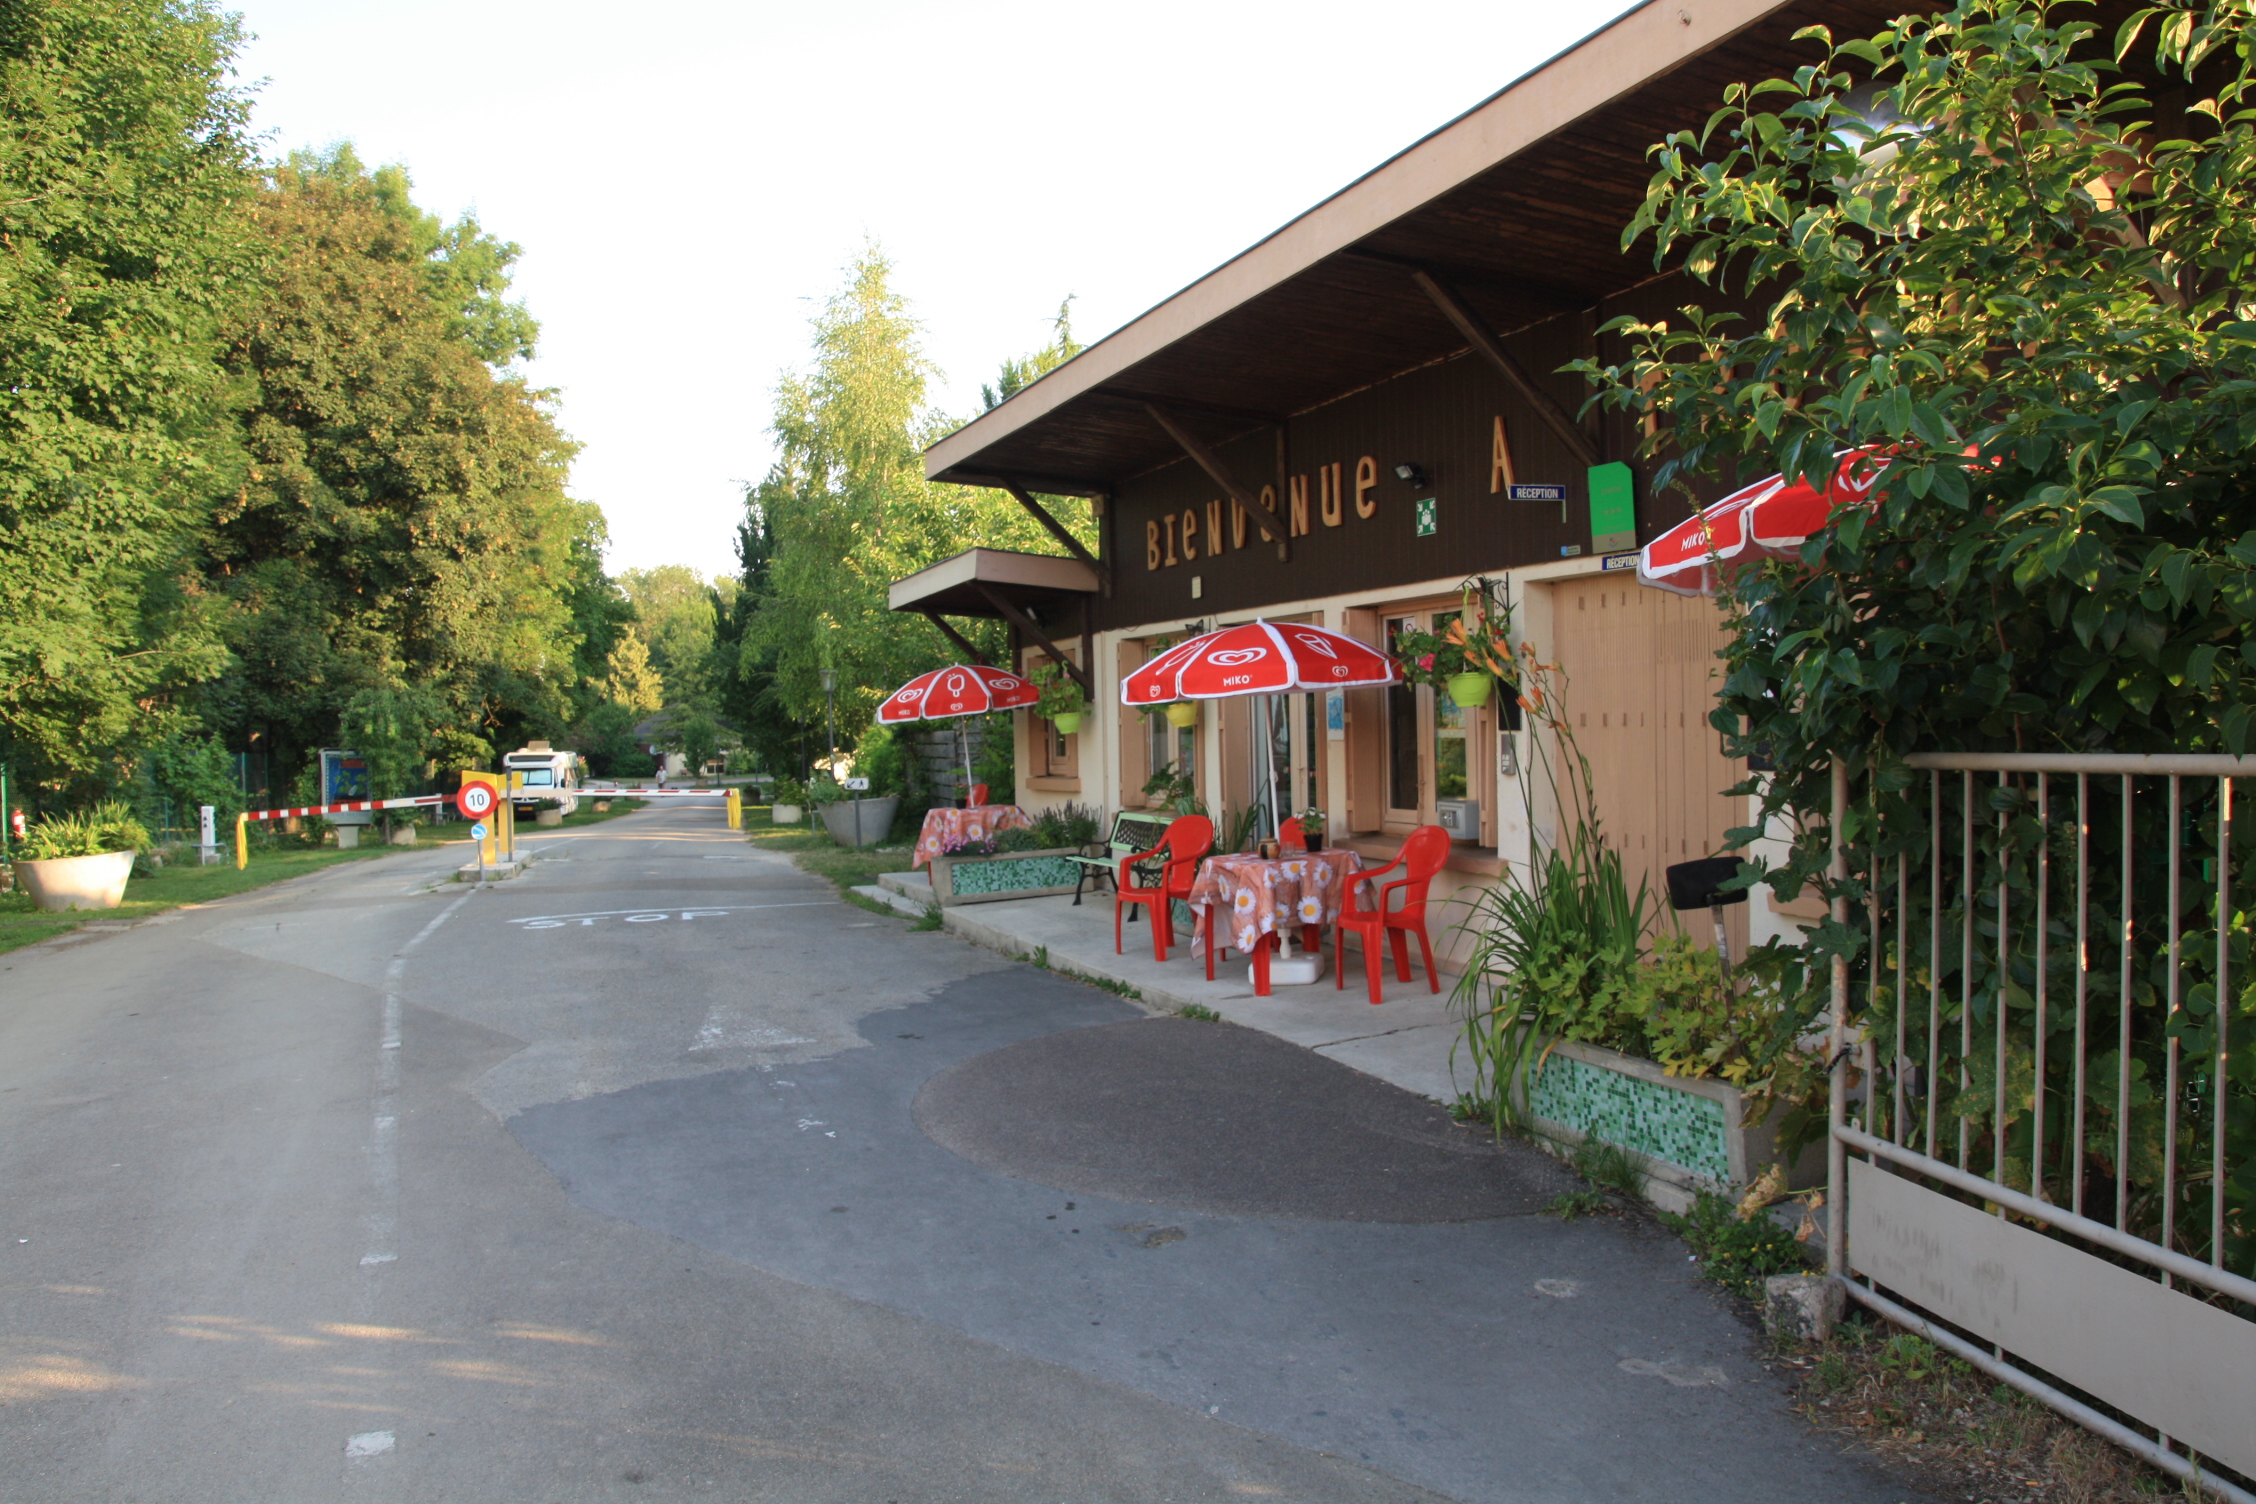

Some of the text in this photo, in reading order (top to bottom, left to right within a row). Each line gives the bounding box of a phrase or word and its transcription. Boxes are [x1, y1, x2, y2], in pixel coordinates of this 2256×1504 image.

[1681, 531, 1706, 552] MIKO
[1223, 675, 1250, 687] MIKO
[469, 793, 485, 807] 10
[522, 910, 730, 929] STOP
